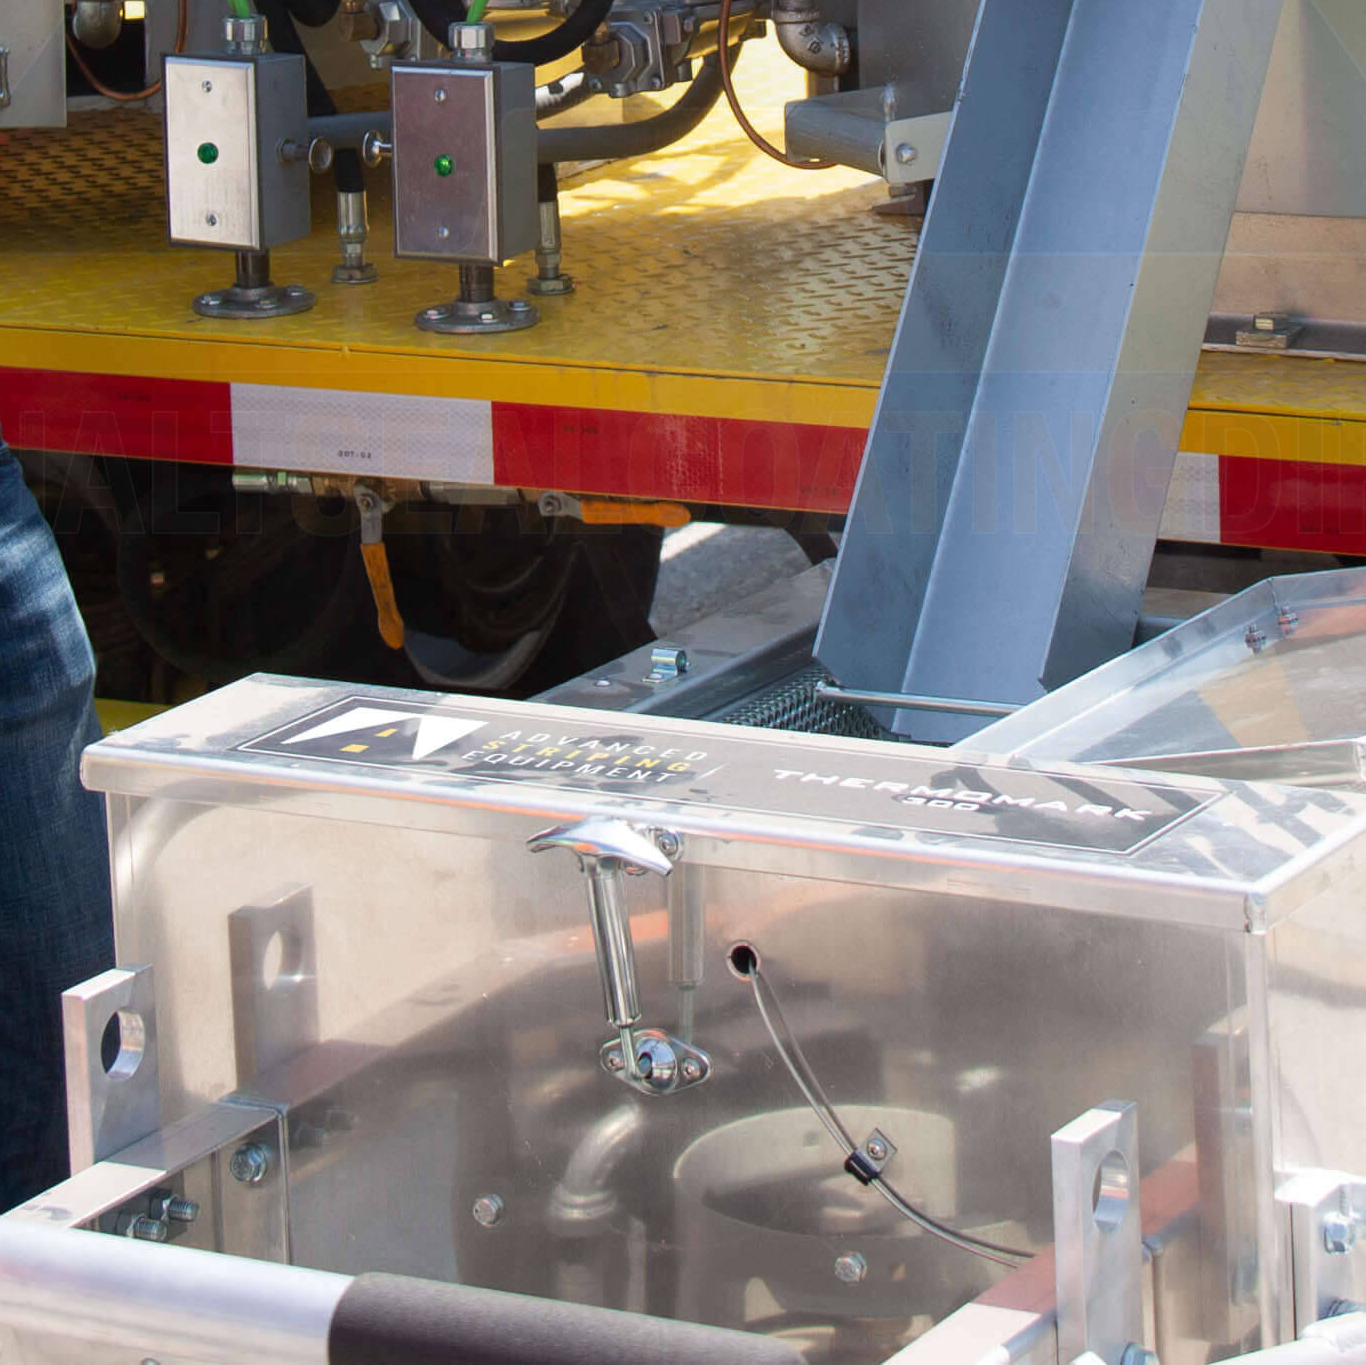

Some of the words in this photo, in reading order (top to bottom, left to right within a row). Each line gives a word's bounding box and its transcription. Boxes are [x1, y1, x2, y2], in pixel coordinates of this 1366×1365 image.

[481, 740, 692, 773] STRIPING
[499, 729, 709, 762] ADVANCED
[460, 749, 678, 783] EQUIPMENT
[771, 768, 1153, 821] THERMOMARK
